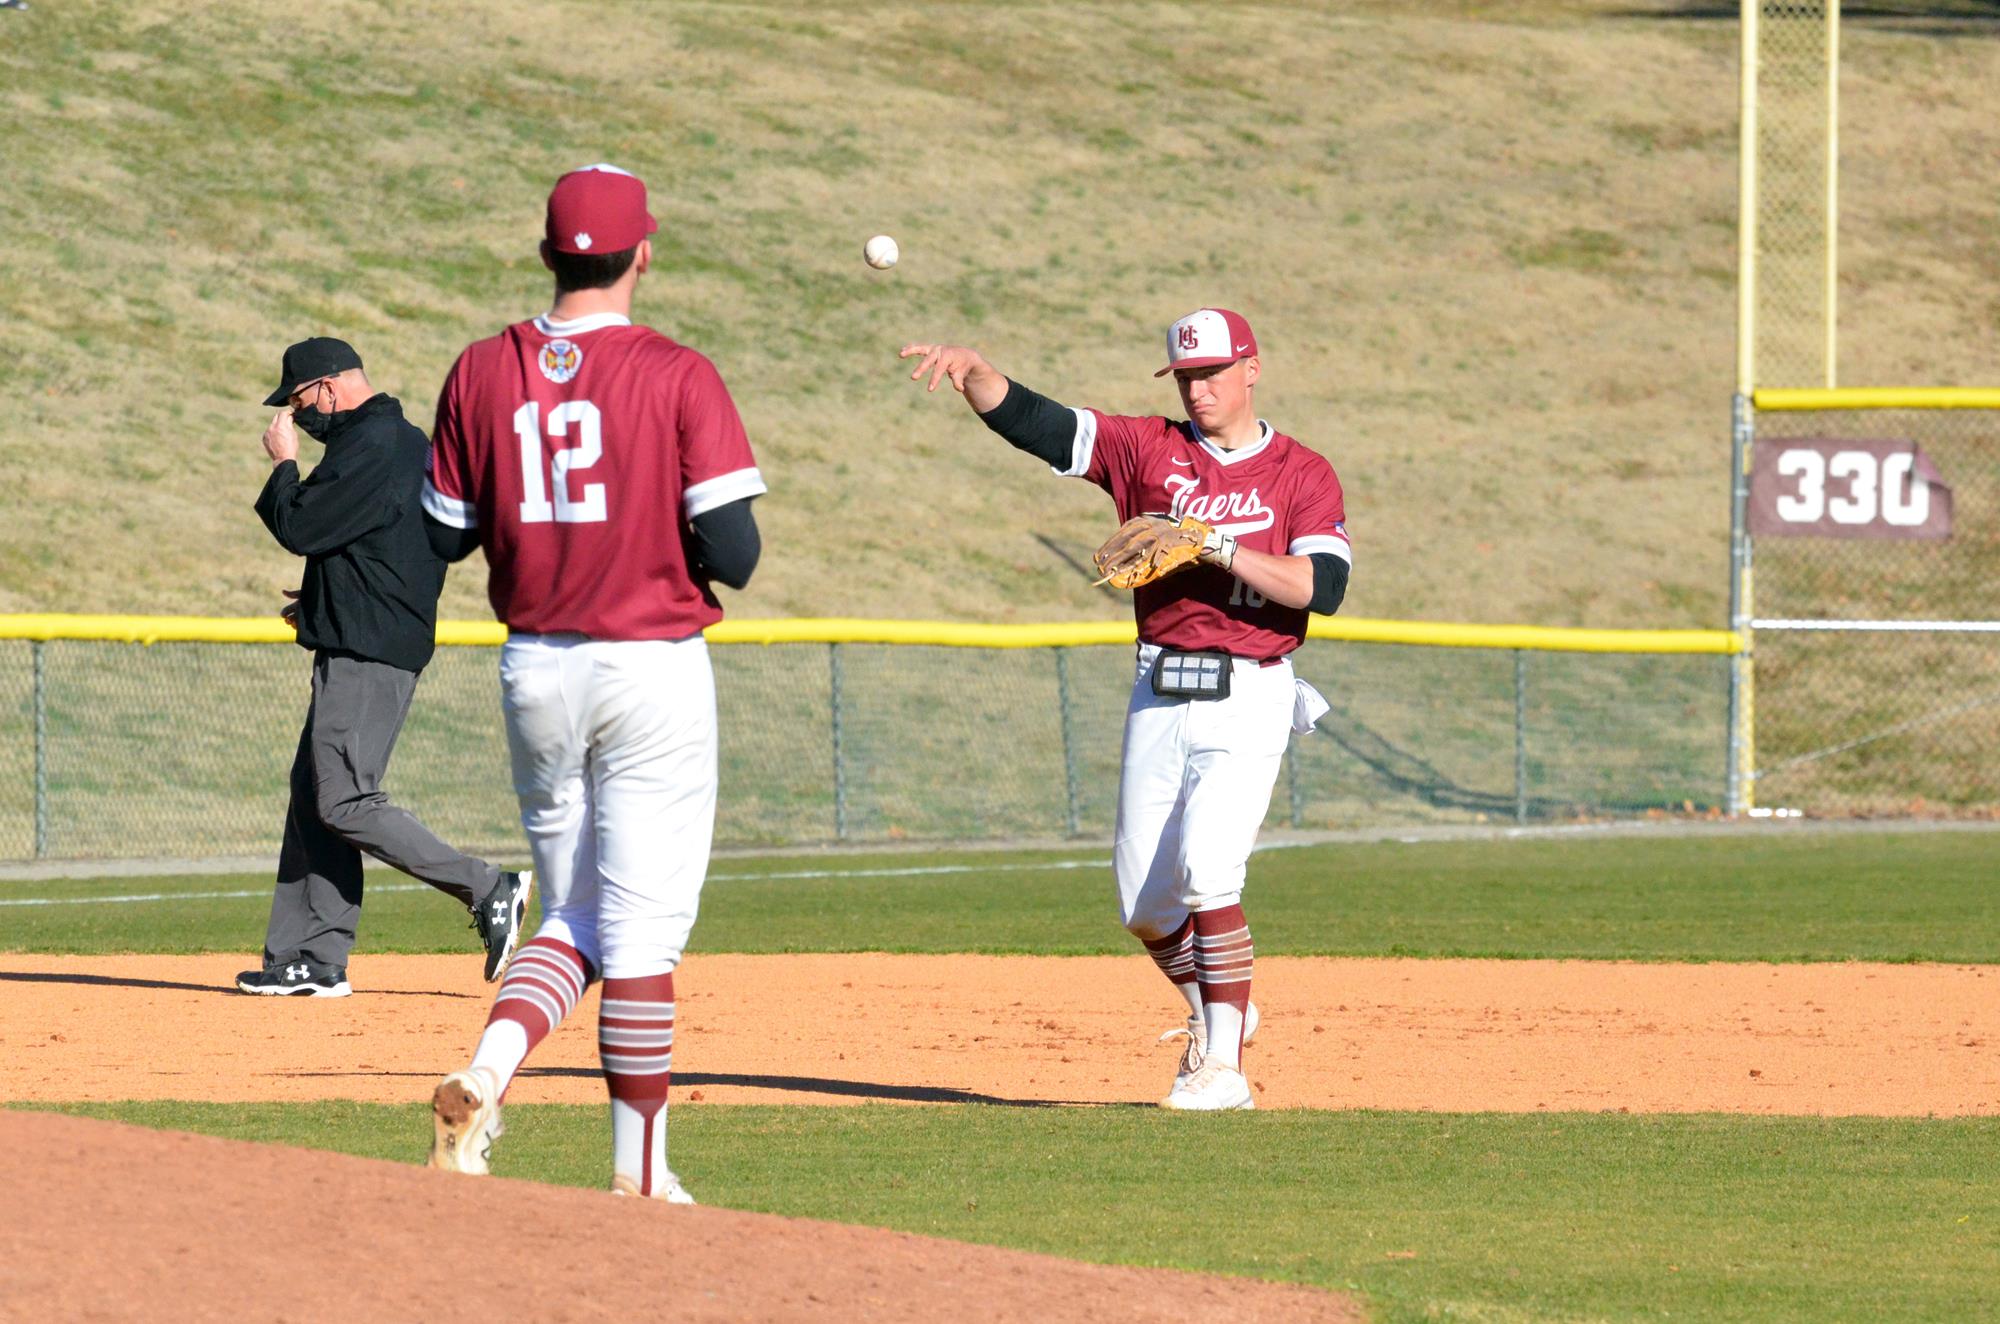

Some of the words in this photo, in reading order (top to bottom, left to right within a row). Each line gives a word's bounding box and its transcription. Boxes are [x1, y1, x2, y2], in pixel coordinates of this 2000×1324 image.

[513, 400, 608, 523] 12
[1776, 449, 1930, 525] 330
[1164, 473, 1275, 532] Tigers
